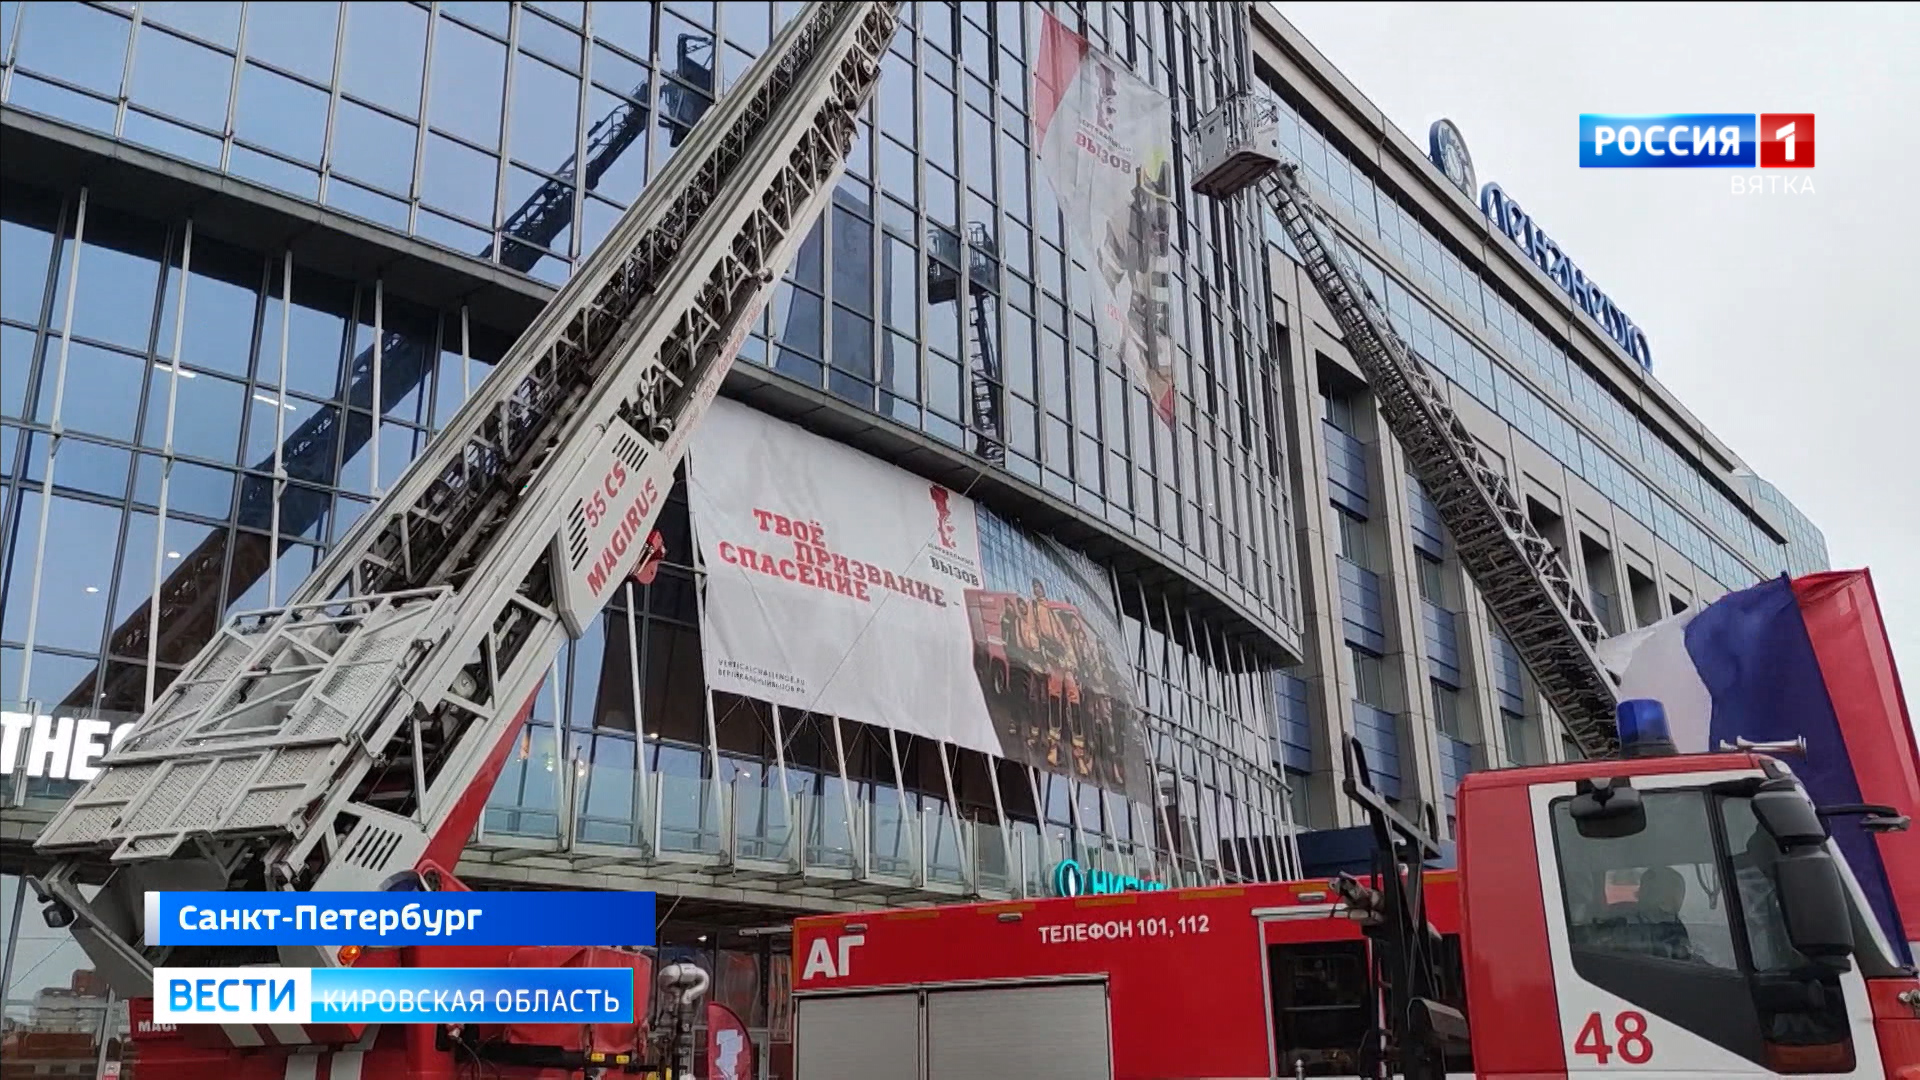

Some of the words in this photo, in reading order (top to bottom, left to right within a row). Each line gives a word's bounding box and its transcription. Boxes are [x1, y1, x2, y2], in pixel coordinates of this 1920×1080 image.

[1074, 131, 1132, 174] ВЫЗОВ
[584, 489, 607, 528] 55
[604, 459, 627, 498] CS
[586, 477, 658, 597] MAGIRUS
[752, 507, 826, 548] ТВОЁ
[718, 541, 871, 602] СПАСЕНИЕ
[793, 540, 947, 608] ПРИЗВАНИЕ
[919, 555, 980, 587] ВЫЗОВ
[1038, 919, 1133, 944] ТЕЛЕФОН
[1136, 917, 1174, 938] 101,
[1178, 914, 1210, 934] 112
[802, 934, 865, 980] АГ
[1574, 1010, 1654, 1065] 48
